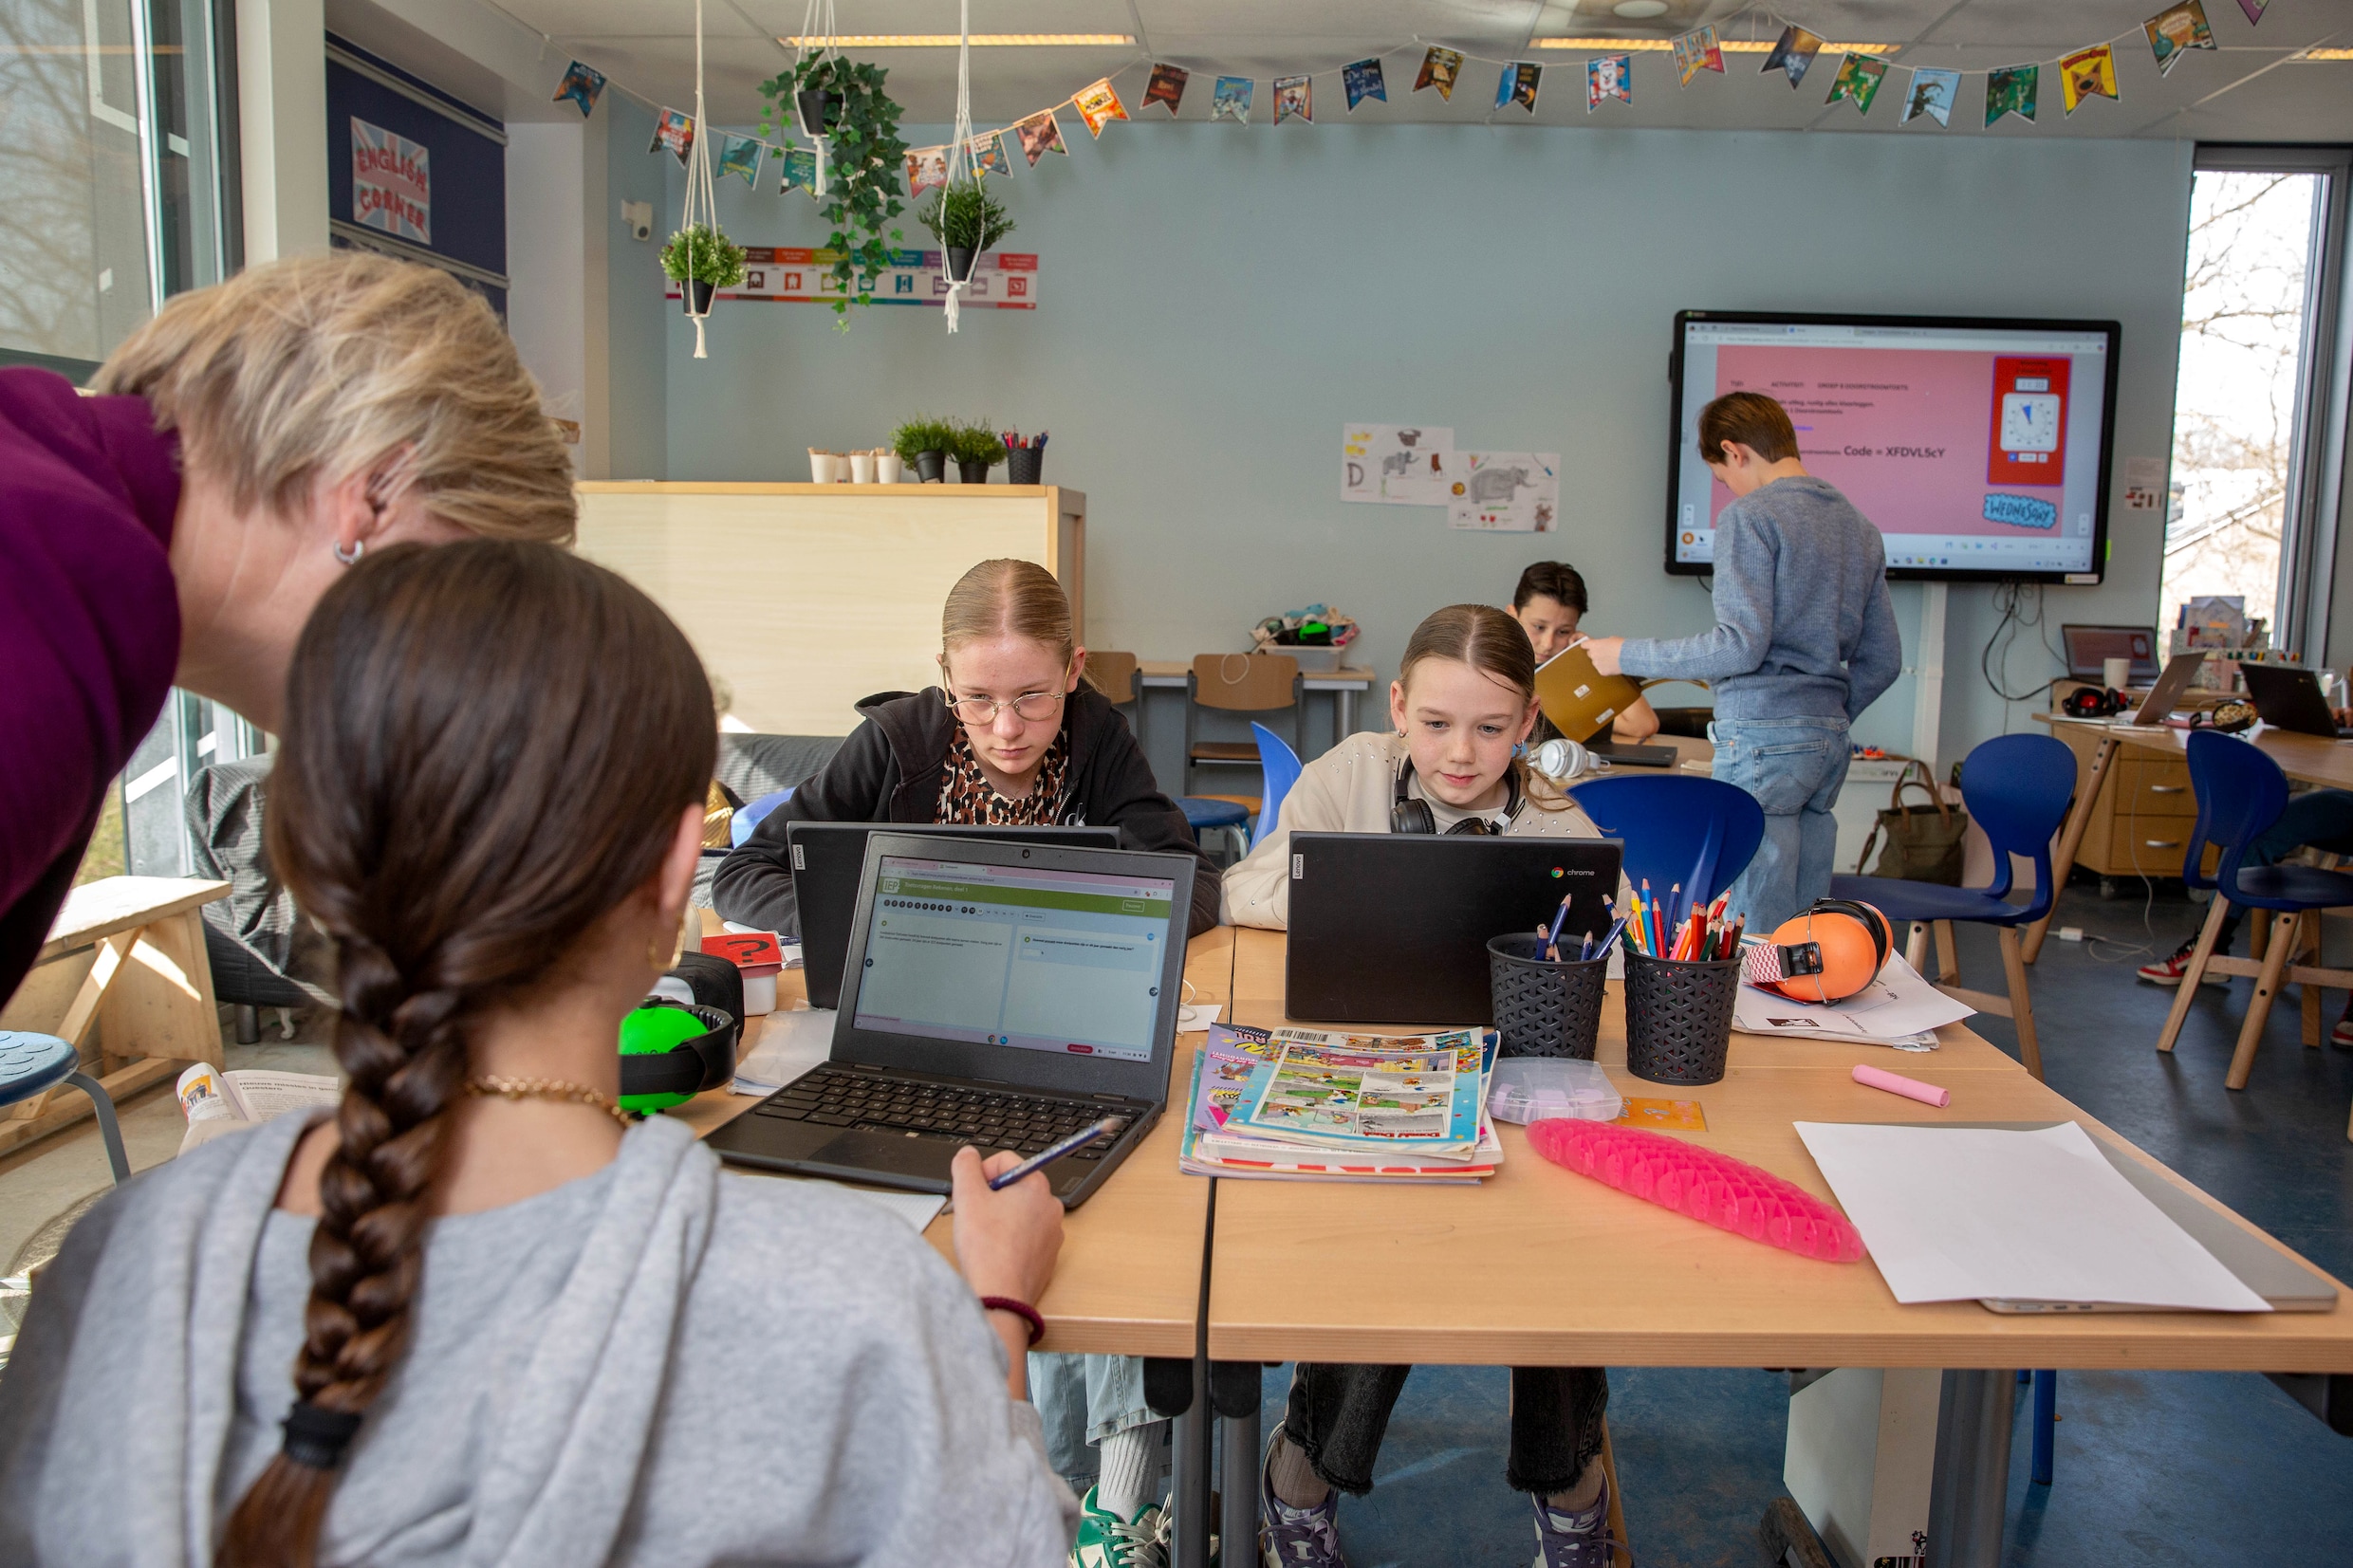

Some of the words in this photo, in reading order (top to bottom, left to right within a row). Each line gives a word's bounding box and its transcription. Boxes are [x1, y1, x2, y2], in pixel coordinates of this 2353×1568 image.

[356, 146, 427, 192] ENGLISH
[360, 187, 425, 229] CORNER
[1843, 446, 1874, 457] Code
[1886, 447, 1946, 458] XFDVL5cY
[1990, 499, 2051, 522] WEDNESDAY
[884, 879, 899, 891] IEP
[1285, 1506, 1302, 1518] NIKE
